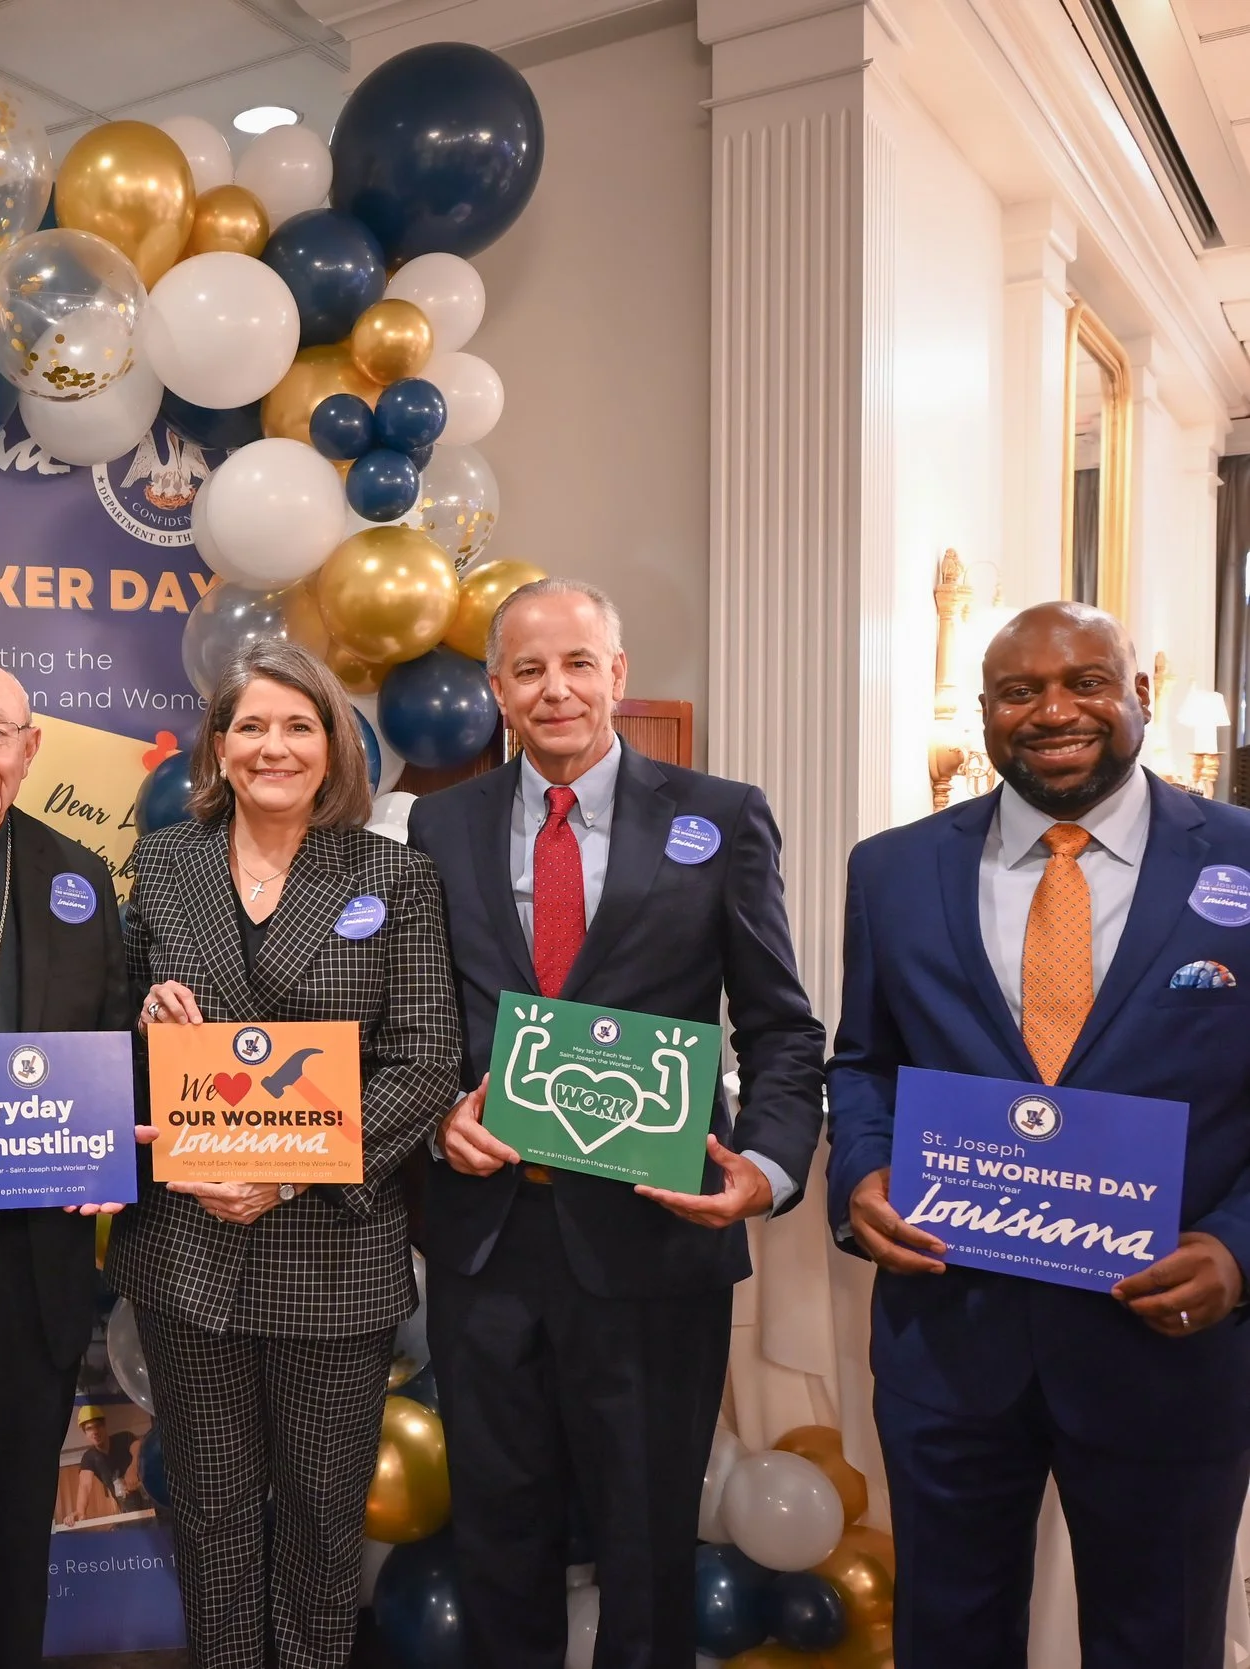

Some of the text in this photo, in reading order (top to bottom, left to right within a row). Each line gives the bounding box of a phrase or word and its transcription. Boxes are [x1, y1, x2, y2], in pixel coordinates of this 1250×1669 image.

[98, 487, 192, 544] DEPARTMENT OF TH
[132, 502, 191, 526] CONFIDEN
[110, 570, 224, 614] DAY
[65, 648, 112, 670] the
[59, 687, 112, 708] and
[122, 688, 210, 711] Wome
[44, 782, 110, 825] Dear
[1203, 896, 1247, 909] Louisiana
[575, 1054, 596, 1063] Joseph
[609, 1060, 631, 1068] Worker
[180, 1072, 219, 1102] We
[555, 1083, 633, 1123] WORK
[168, 1110, 343, 1126] OUR WORKERS!
[169, 1123, 329, 1157] Louisiana
[922, 1131, 1025, 1158] St. Joseph
[527, 1147, 649, 1177] www.saintjosephtheworker.com
[922, 1150, 1158, 1202] THE WORKER DAY
[922, 1172, 1021, 1194] May 1st of Each Year
[904, 1182, 1154, 1261] Louisiana
[66, 1556, 164, 1574] Resolution
[57, 1584, 74, 1598] Jr.
